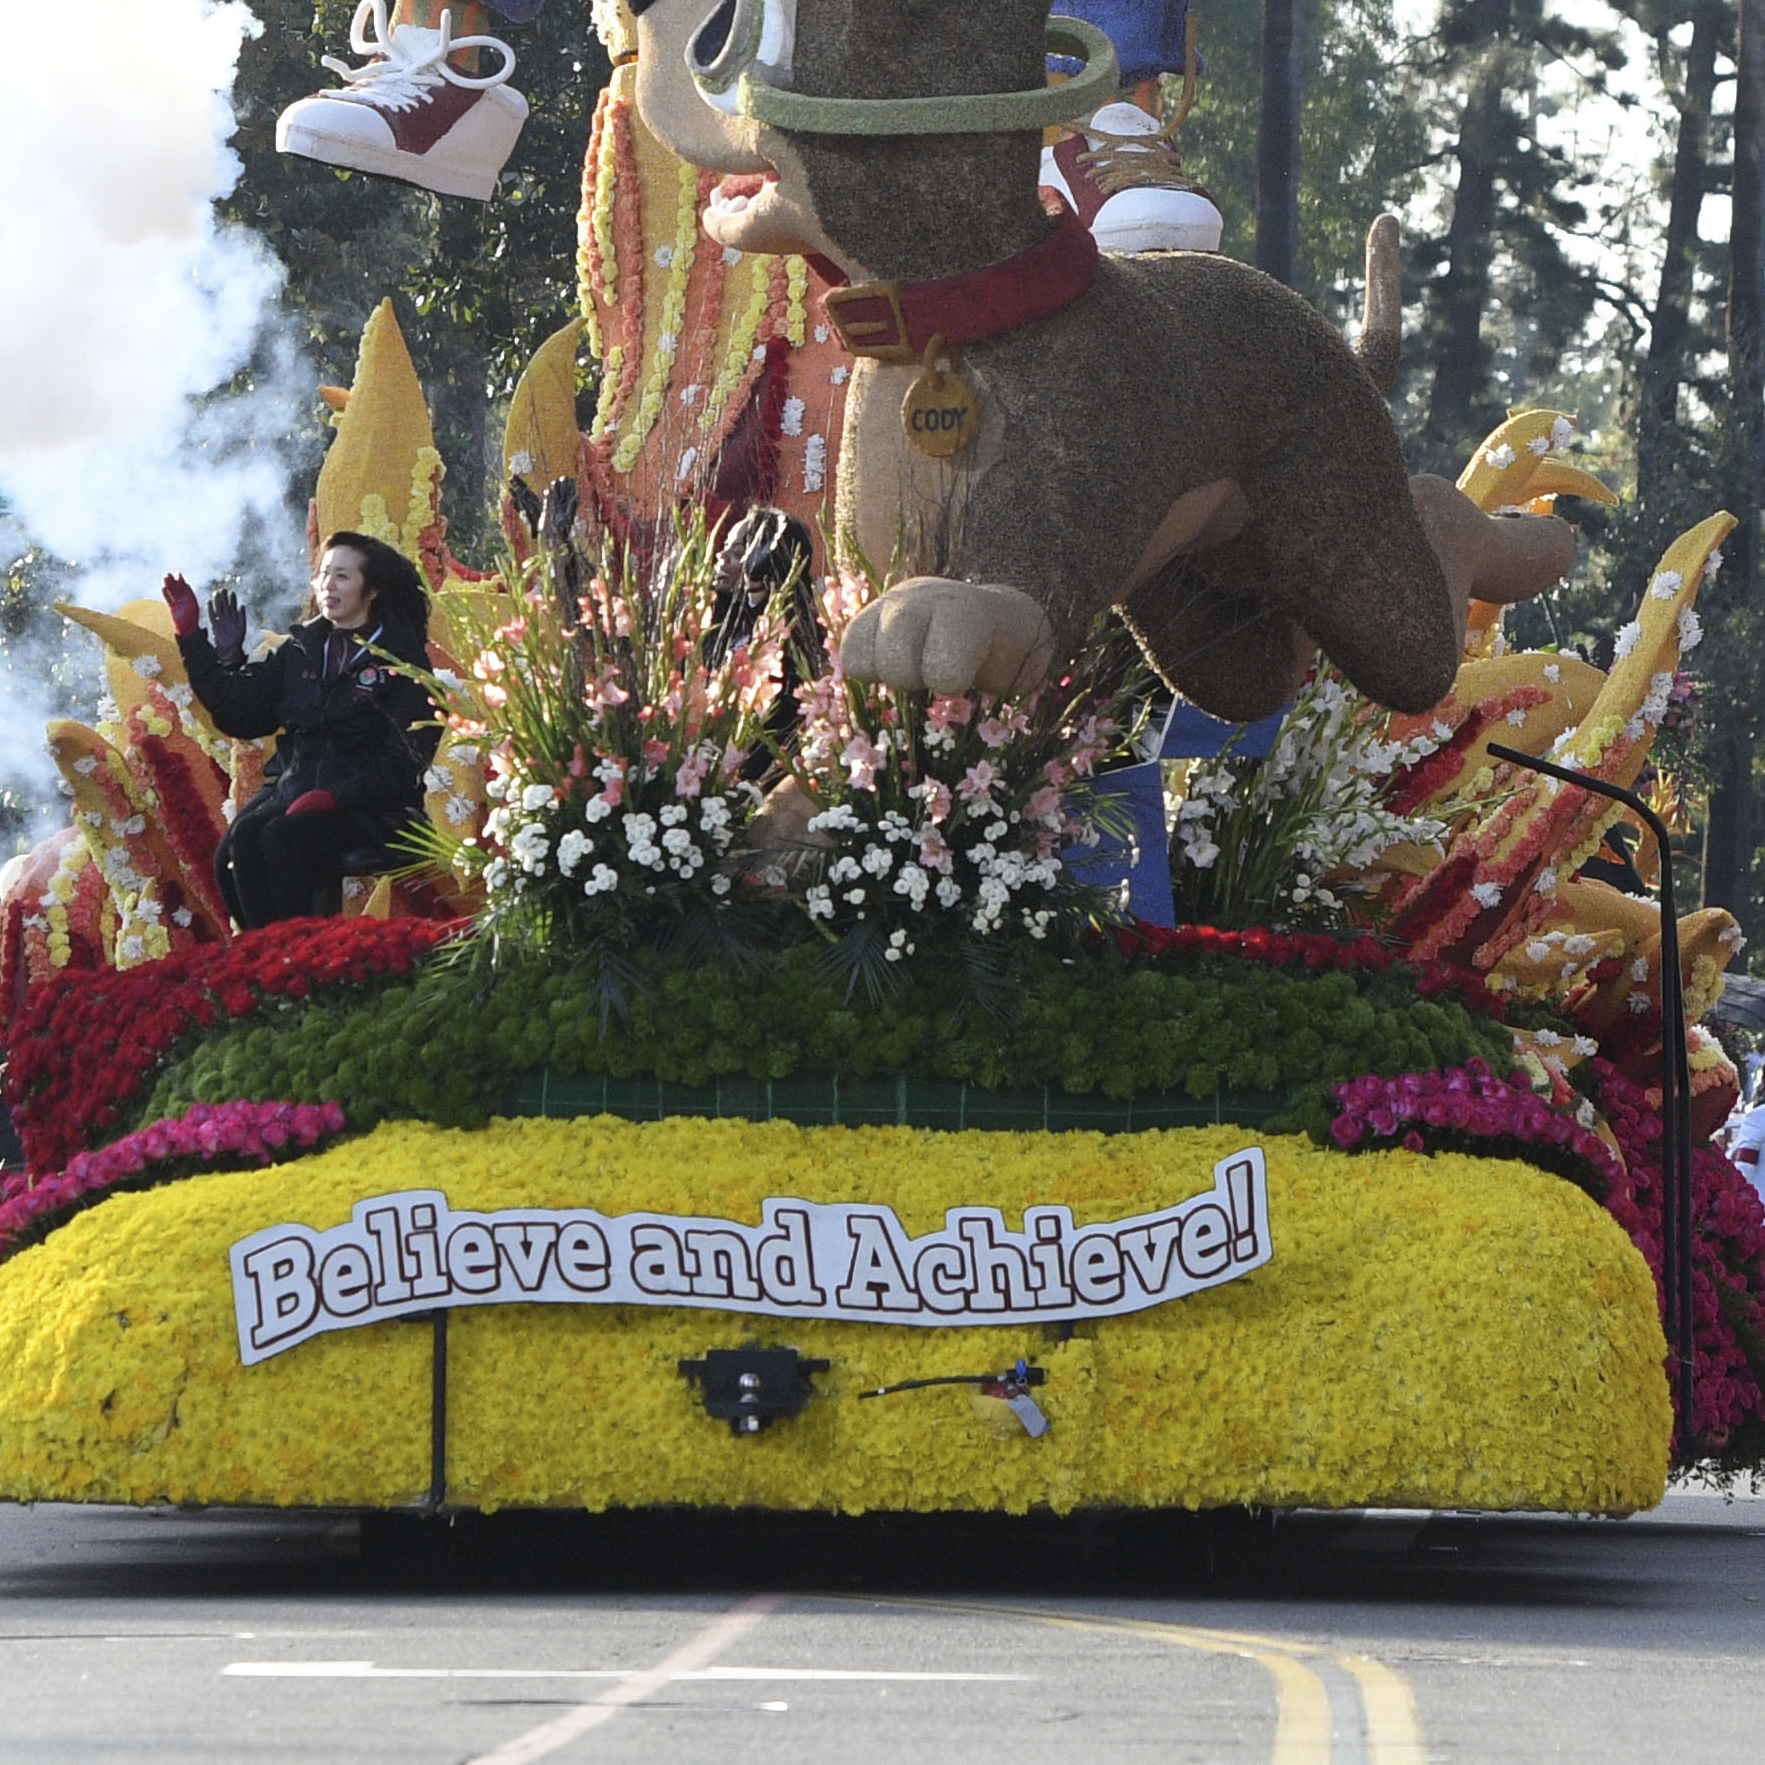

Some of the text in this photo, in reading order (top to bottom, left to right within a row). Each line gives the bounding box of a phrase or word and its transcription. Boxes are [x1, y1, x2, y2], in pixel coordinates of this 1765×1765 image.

[911, 407, 968, 433] CODY
[244, 1160, 1258, 1349] Believe and Achieve!
